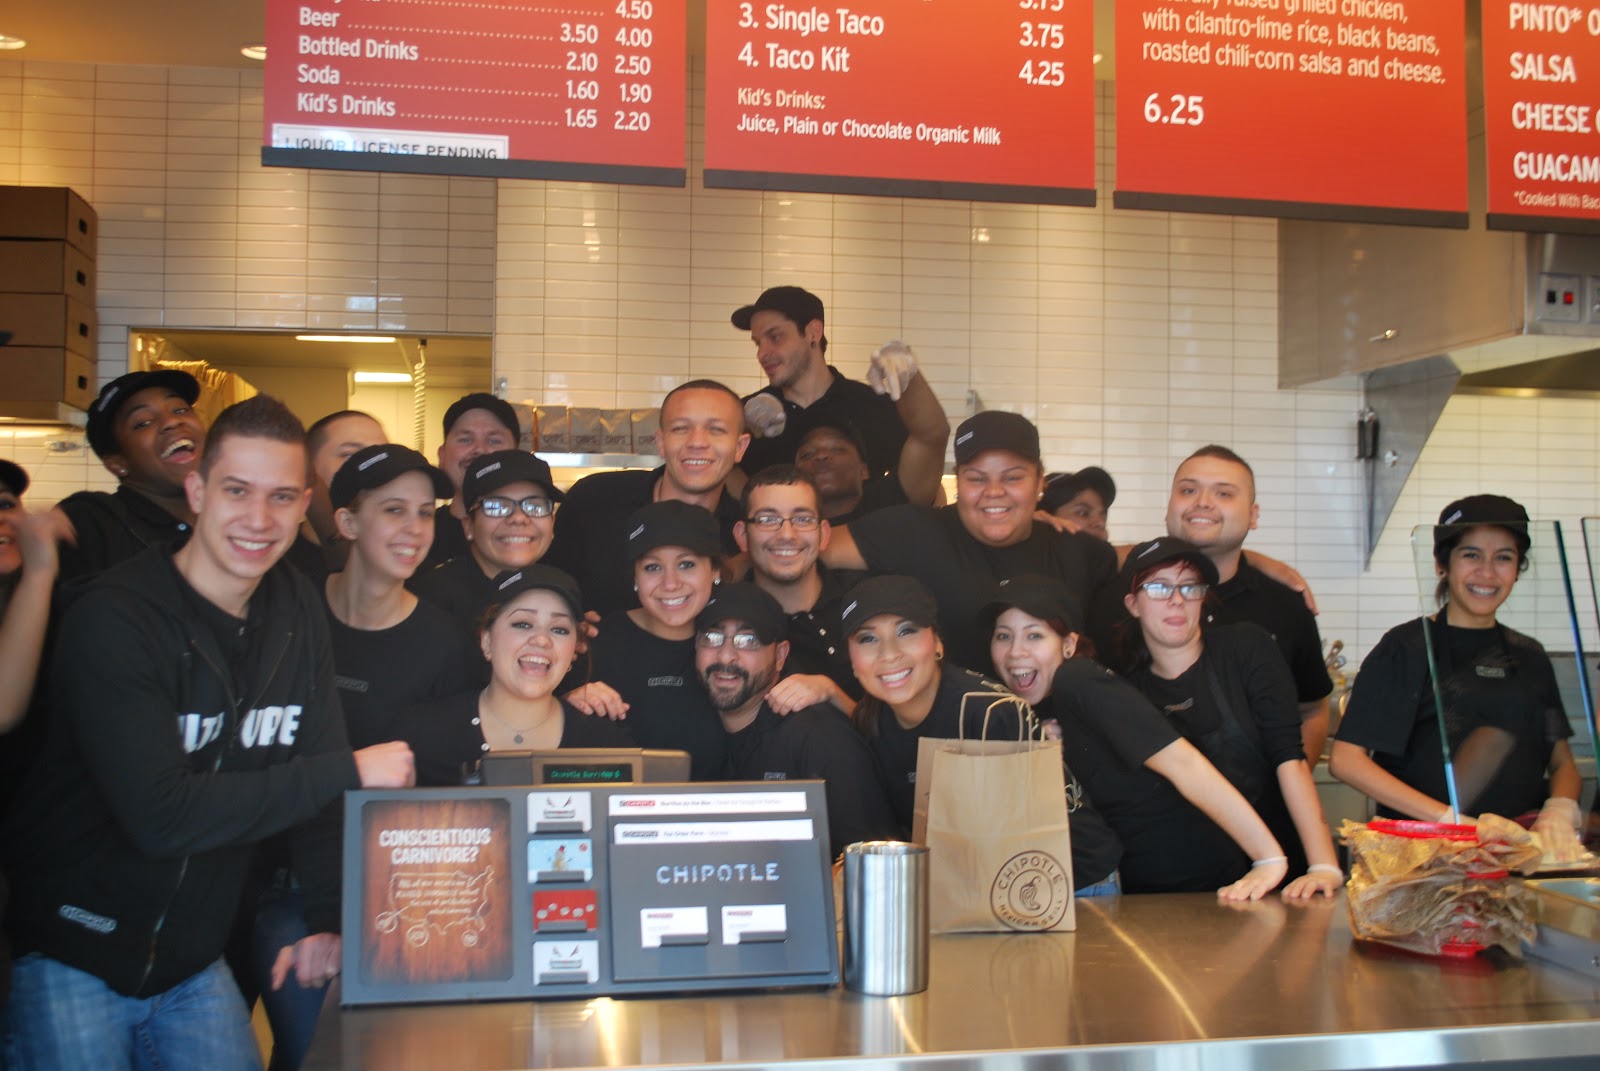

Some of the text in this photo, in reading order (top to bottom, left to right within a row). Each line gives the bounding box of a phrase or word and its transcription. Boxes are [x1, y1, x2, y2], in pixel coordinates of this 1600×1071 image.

[615, 0, 653, 20] 4.50
[738, 2, 1064, 49] 3. Single Taco 3.75
[299, 6, 653, 48] Beer 3.50 4.00
[1142, 7, 1440, 56] with cilantro-lime rice, black beans,
[299, 35, 652, 75] Bottled Drinks 2.10 2.50
[737, 41, 1065, 86] 4. Taco Kit 4.25
[1142, 40, 1446, 84] roasted chili-corn salsa and cheese.
[1509, 51, 1577, 84] SALSA
[297, 63, 652, 104] Soda 1.60 1.90
[737, 88, 826, 110] Kid's Drinks:
[297, 92, 651, 132] Kid's Drinks 1.65 2.20
[1144, 92, 1204, 126] 6.25
[1511, 101, 1592, 134] CHEESE
[737, 114, 1001, 145] Juice, Plain or Chocolate Organic Milk
[426, 145, 497, 159] PENDING
[1513, 151, 1600, 183] GUACAM
[379, 827, 491, 847] CONSCIENTIOUS
[391, 846, 479, 865] CARNIVORE?
[656, 862, 780, 884] CHIPOTLE
[998, 855, 1064, 890] CHIPOTLE
